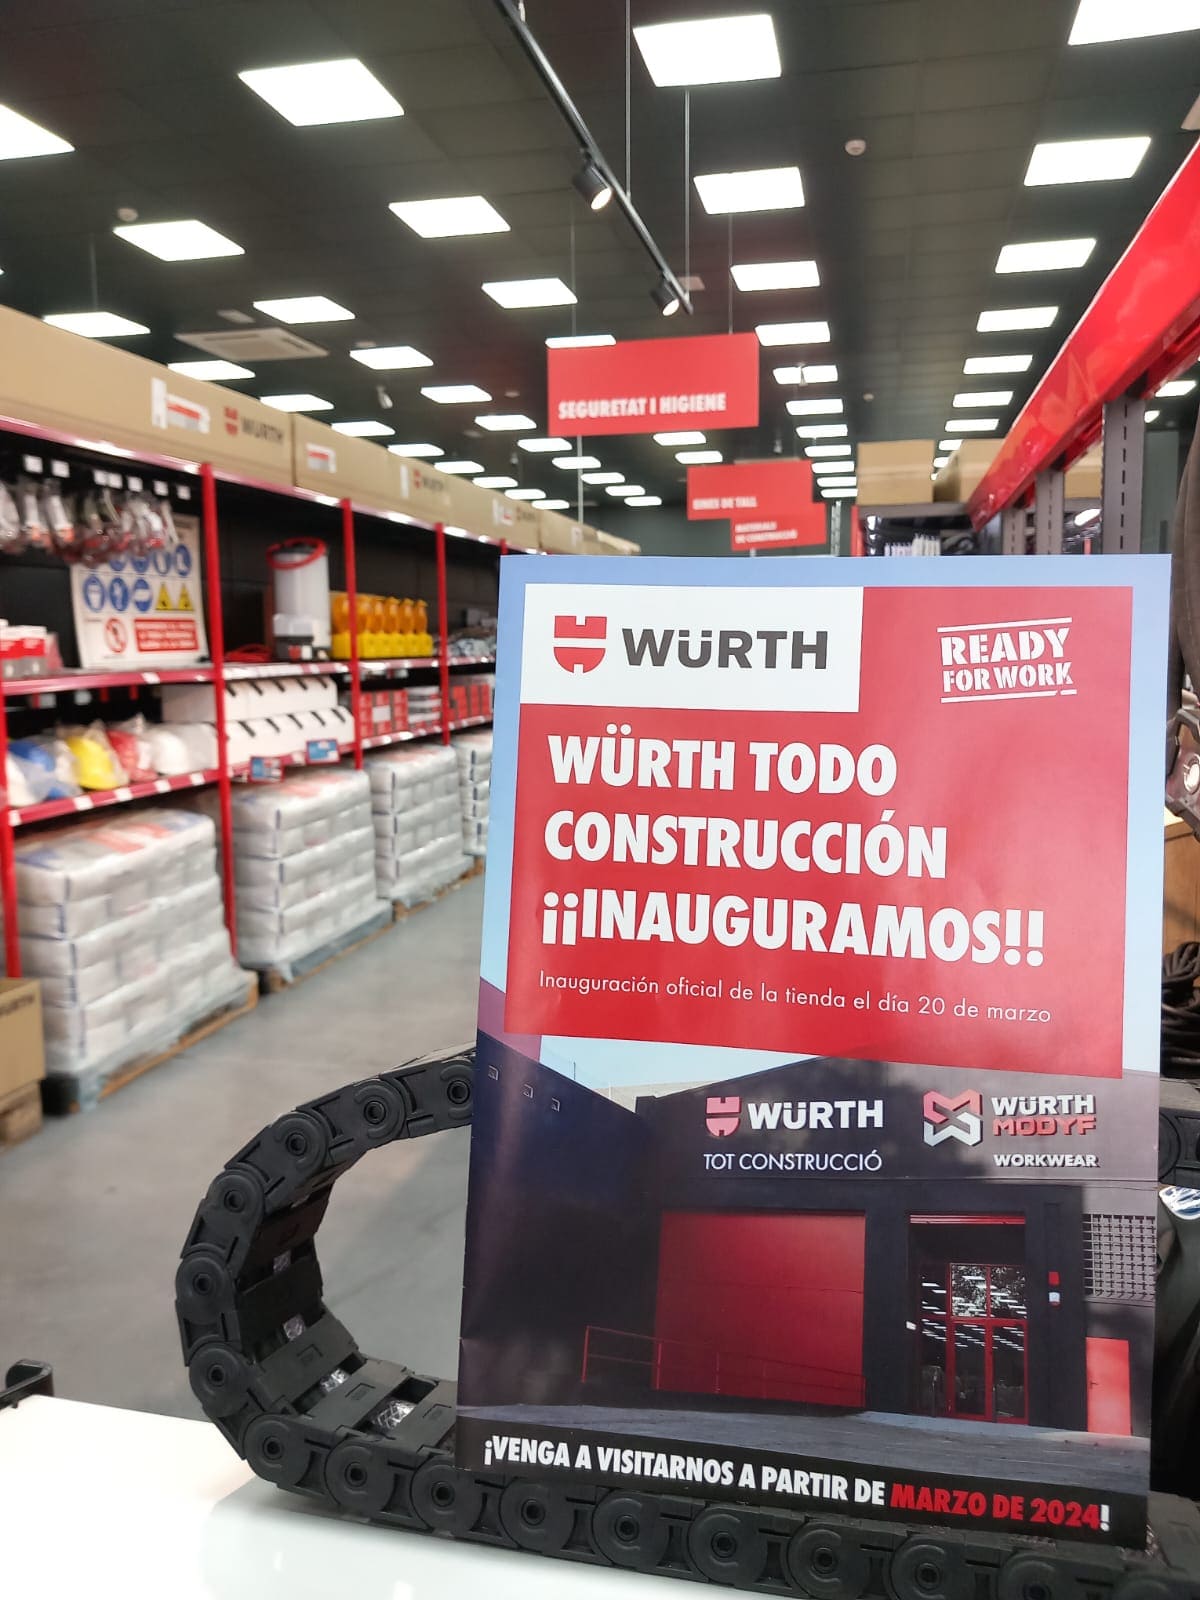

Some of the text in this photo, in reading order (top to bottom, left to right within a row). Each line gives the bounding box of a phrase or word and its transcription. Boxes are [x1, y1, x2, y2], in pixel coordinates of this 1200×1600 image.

[558, 393, 726, 420] SEGURETAT I HIGIENE
[622, 628, 828, 669] WÜRTH
[941, 627, 1070, 666] READY
[943, 661, 1073, 693] FOR WORK
[547, 723, 897, 797] WÜRTH TODO
[544, 809, 947, 879] CONSTRUCCIÓN
[541, 887, 1045, 967] ¡¡INAUGURAMOS!!
[539, 970, 1051, 1023] Inauguración oficial de la tienda el día 20 de marzo
[747, 1099, 884, 1130] WÜRTH
[991, 1094, 1095, 1116] WÜRTH
[992, 1114, 1096, 1137] MODYF
[703, 1149, 883, 1172] TOT CONSTRUCCIÓ
[993, 1153, 1100, 1168] WORKWEAR
[484, 1435, 1111, 1532] ¡VENGA A VISITARNOS A PARTIR DE MARZO DE 2024!
